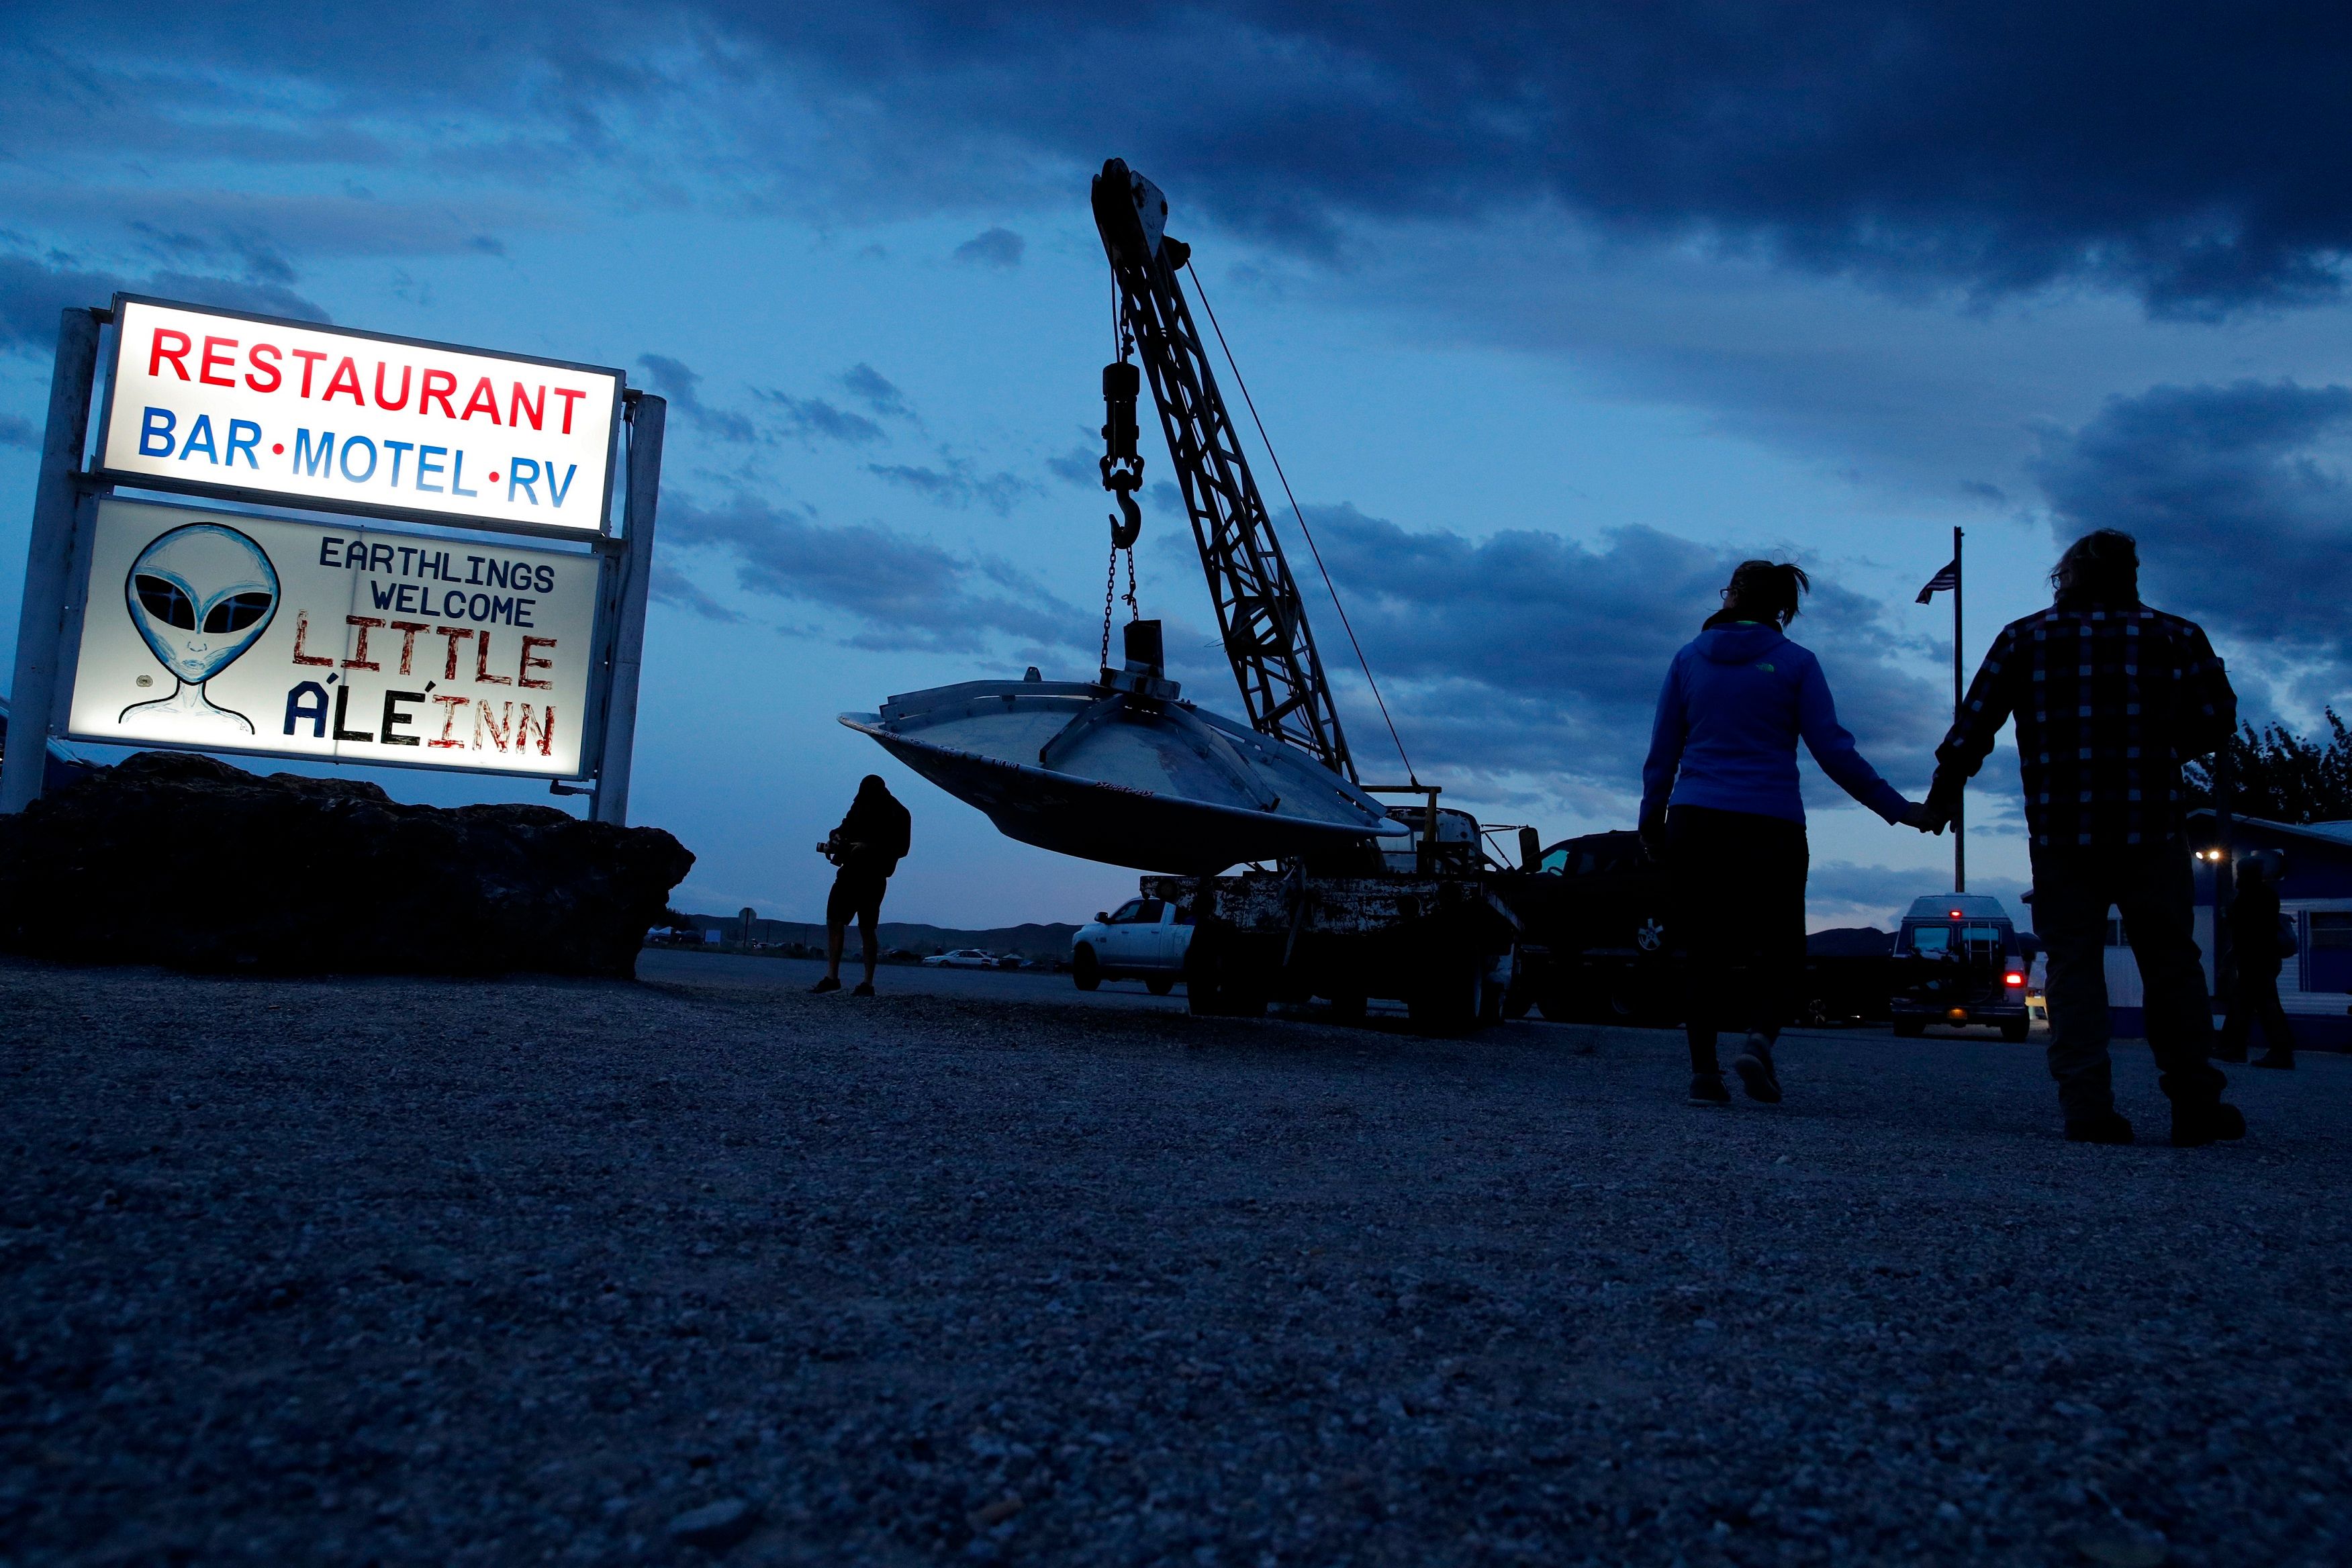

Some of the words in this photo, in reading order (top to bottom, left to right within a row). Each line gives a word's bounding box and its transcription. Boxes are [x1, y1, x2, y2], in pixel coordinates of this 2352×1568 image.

[148, 327, 586, 436] RESTAURANT
[138, 405, 263, 471] BAR
[292, 427, 478, 499] MOTEL
[507, 456, 578, 509] RV
[319, 536, 555, 593] EARTHLINGS
[371, 580, 536, 628] WELCOME
[291, 608, 558, 690] LITTLE
